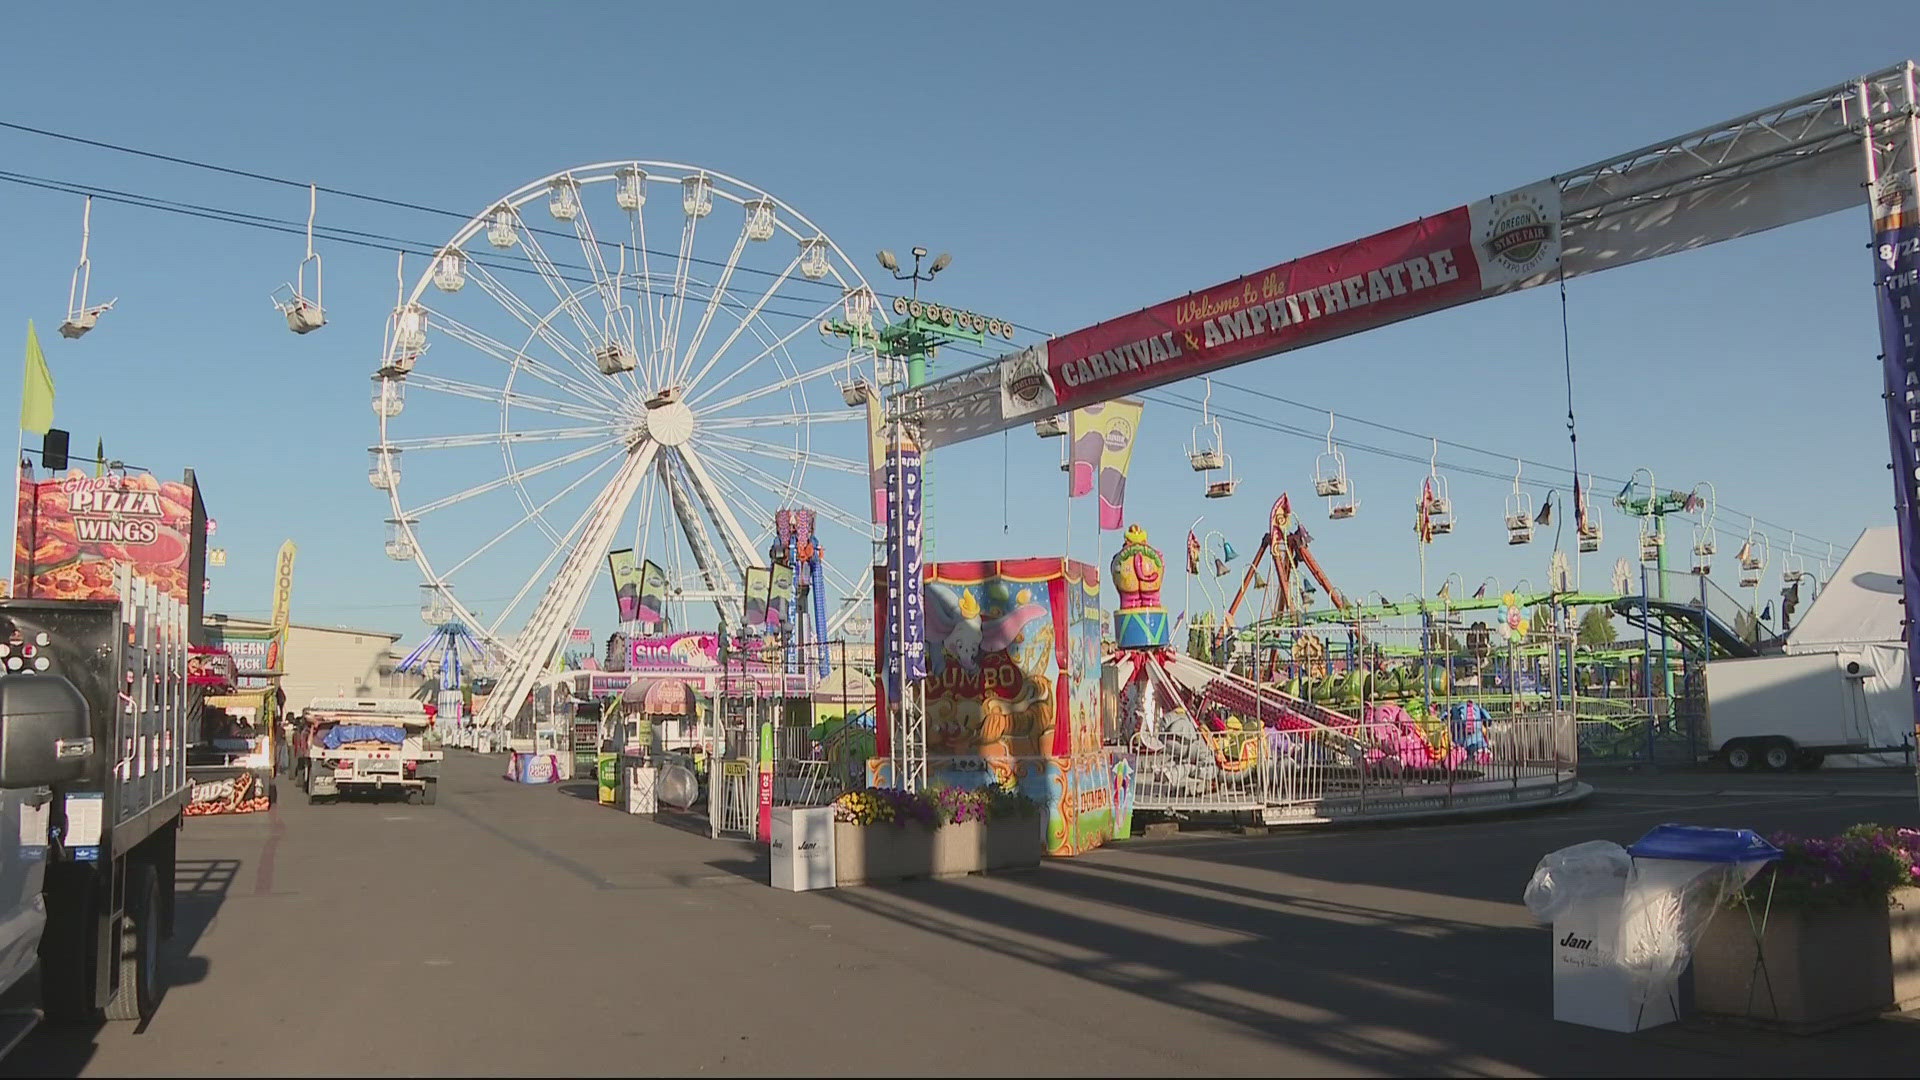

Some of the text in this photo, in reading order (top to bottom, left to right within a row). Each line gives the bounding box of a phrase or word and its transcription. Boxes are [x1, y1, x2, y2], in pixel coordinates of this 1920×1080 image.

[1500, 213, 1531, 231] OREGON
[1494, 227, 1545, 250] STATE FAIR
[1176, 273, 1285, 325] Welcome to the
[1061, 249, 1459, 388] CARNIVAL & AMPHITHEATRE
[70, 491, 161, 515] PIZZA
[77, 519, 156, 542] WINGS
[907, 473, 917, 636] DYLAN SCOTT
[635, 644, 689, 664] SUGAR
[908, 650, 920, 659] PM
[926, 665, 1015, 693] DUMBO
[192, 778, 236, 803] EADS
[1560, 932, 1593, 950] Jani
